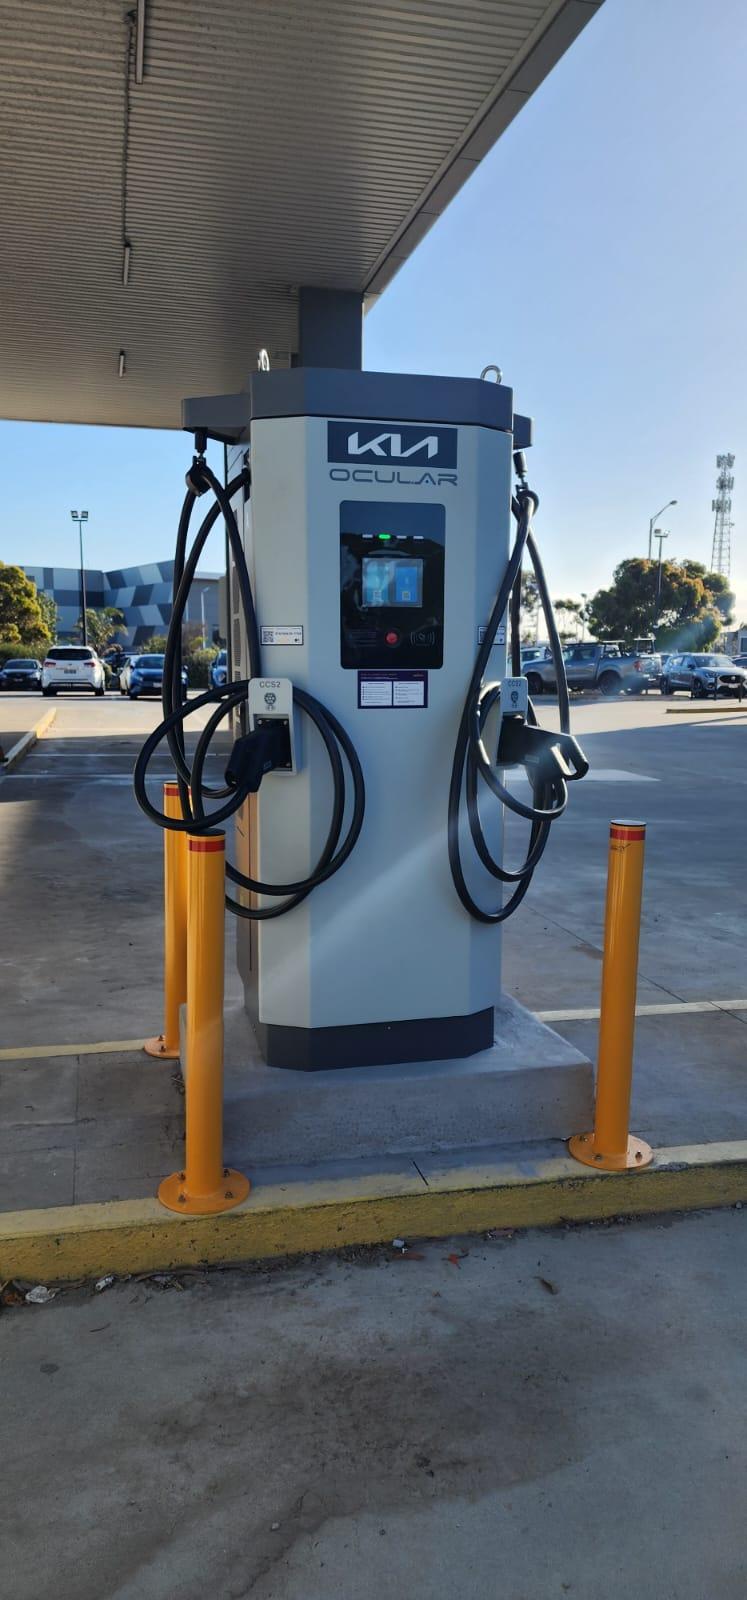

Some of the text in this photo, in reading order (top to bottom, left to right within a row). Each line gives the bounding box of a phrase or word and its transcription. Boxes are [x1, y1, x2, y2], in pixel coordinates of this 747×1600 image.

[347, 431, 439, 459] KIA
[329, 468, 458, 486] OCULAR
[259, 680, 281, 688] CCS2
